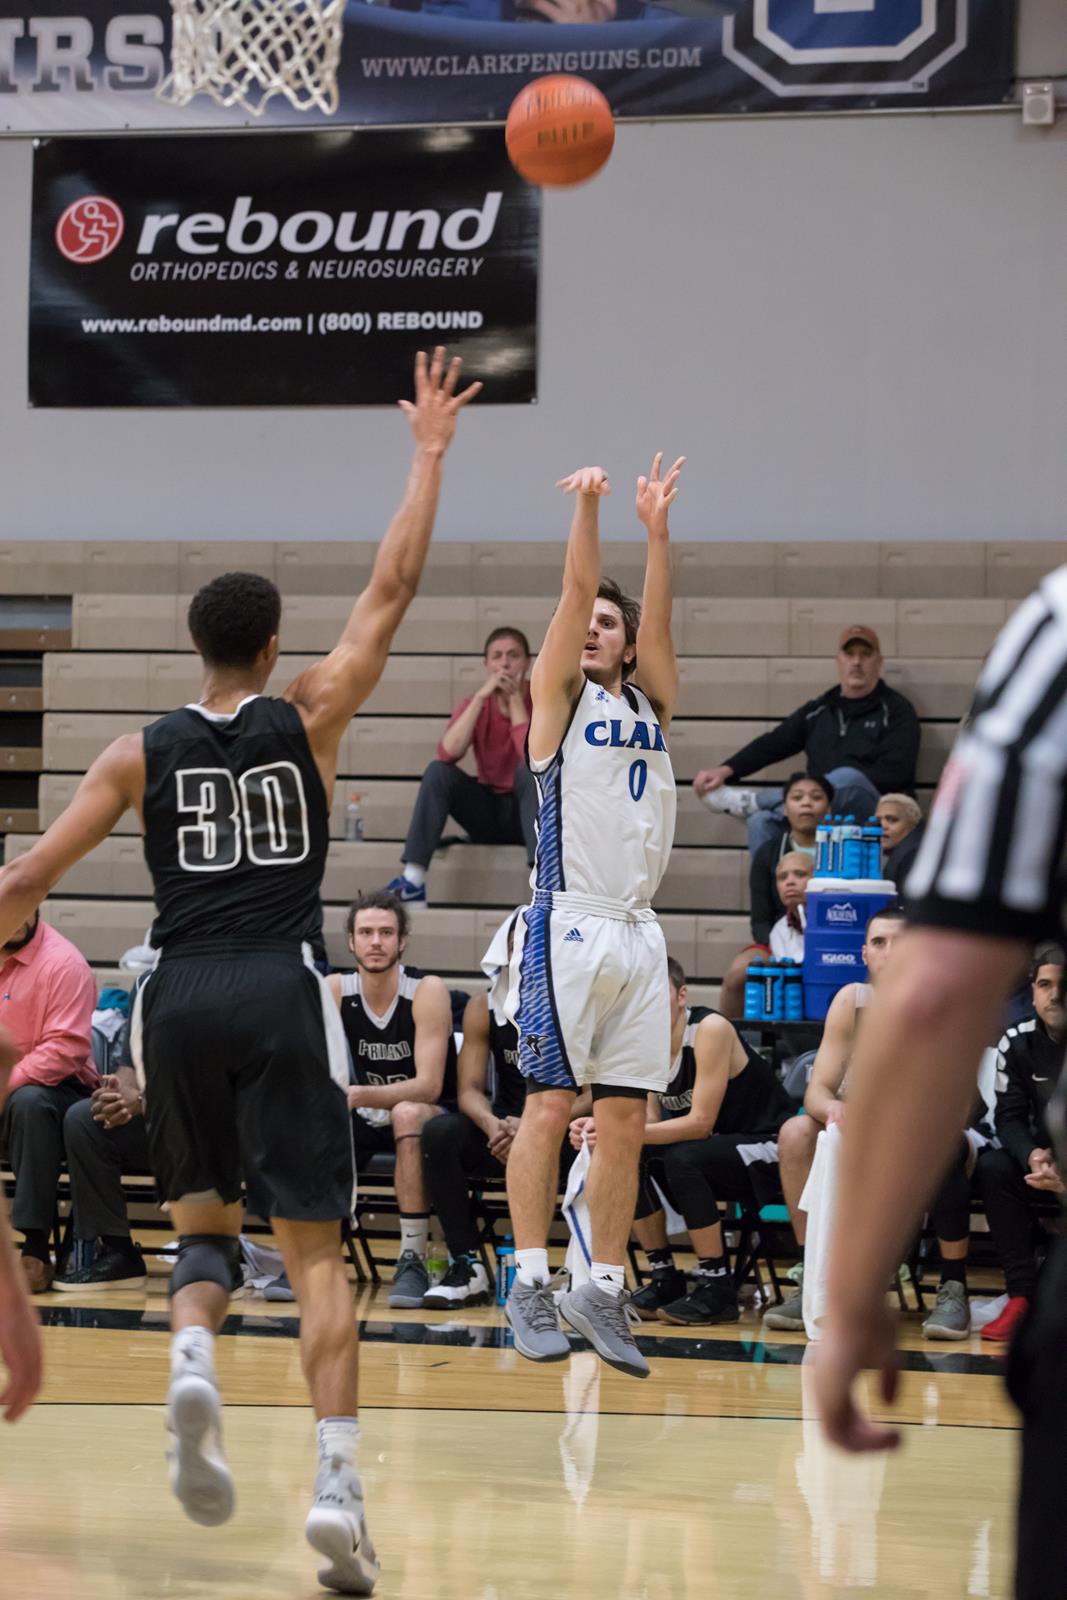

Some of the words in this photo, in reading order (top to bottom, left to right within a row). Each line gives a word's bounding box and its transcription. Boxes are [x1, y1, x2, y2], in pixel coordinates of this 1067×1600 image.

[360, 46, 703, 78] WWW.CLARKPENGUINS.COM
[136, 191, 503, 255] rebound
[130, 261, 279, 282] ORTHOPEDICS
[284, 260, 300, 280] &
[307, 257, 485, 279] NEUROSURGERY
[81, 314, 302, 333] www.reboundmd.com
[318, 312, 372, 334] (800)
[377, 311, 484, 330] REBOUND
[629, 759, 648, 802] 0
[175, 761, 310, 872] 30
